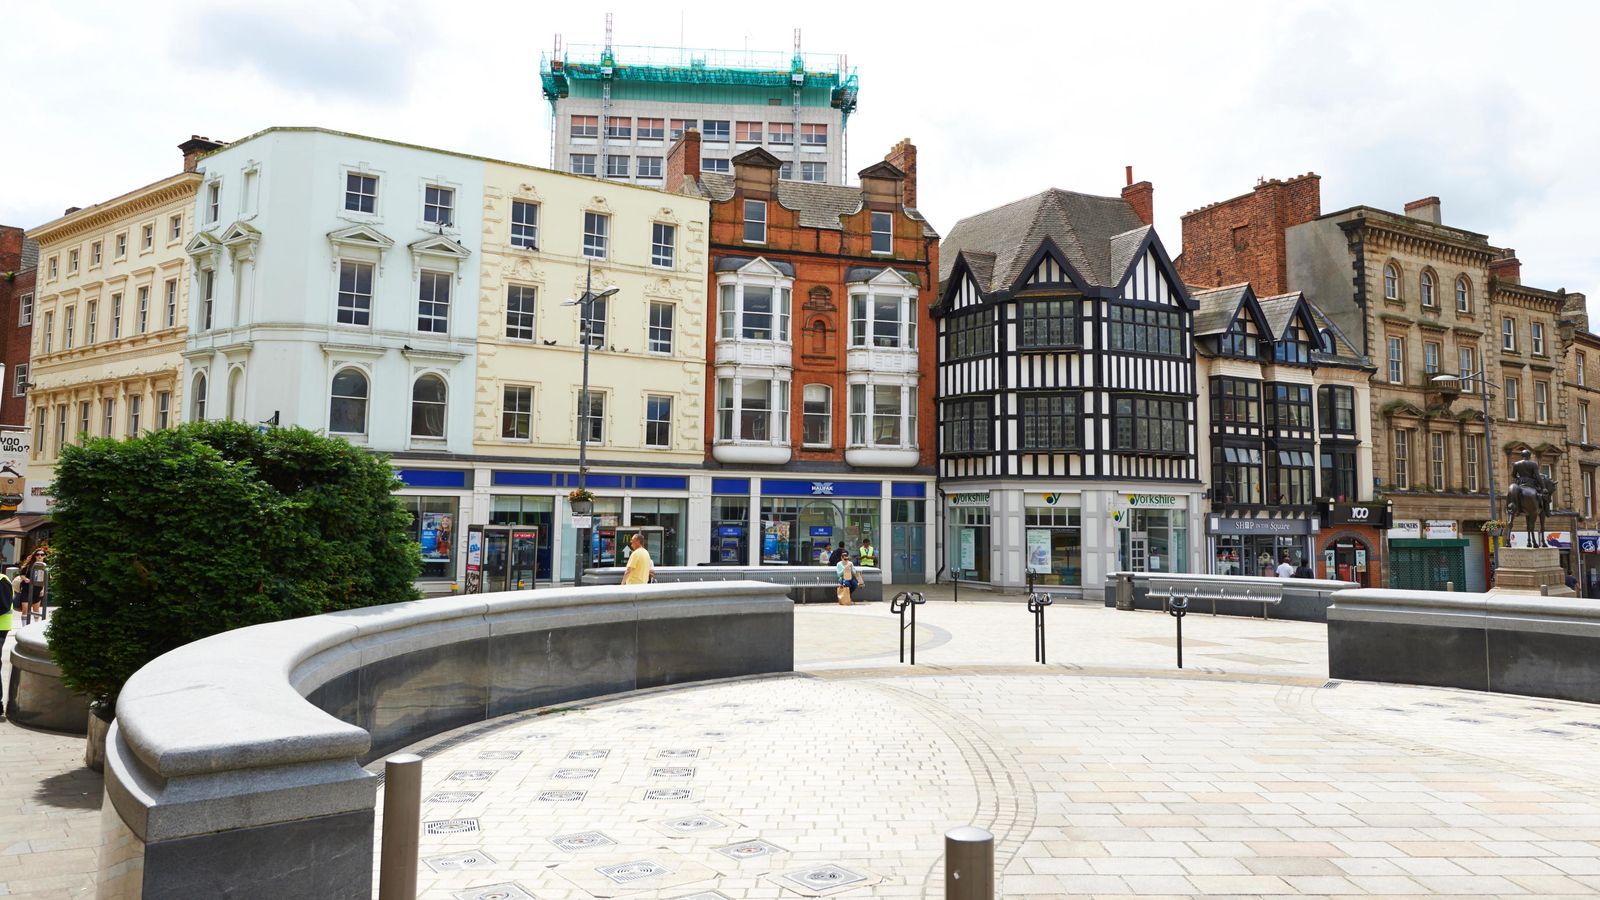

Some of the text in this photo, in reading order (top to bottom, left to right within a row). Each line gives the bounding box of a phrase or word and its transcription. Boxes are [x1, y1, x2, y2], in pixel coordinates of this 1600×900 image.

[1351, 507, 1369, 519] YOO
[1235, 521, 1255, 530] SHOP
[1269, 521, 1290, 532] Square
